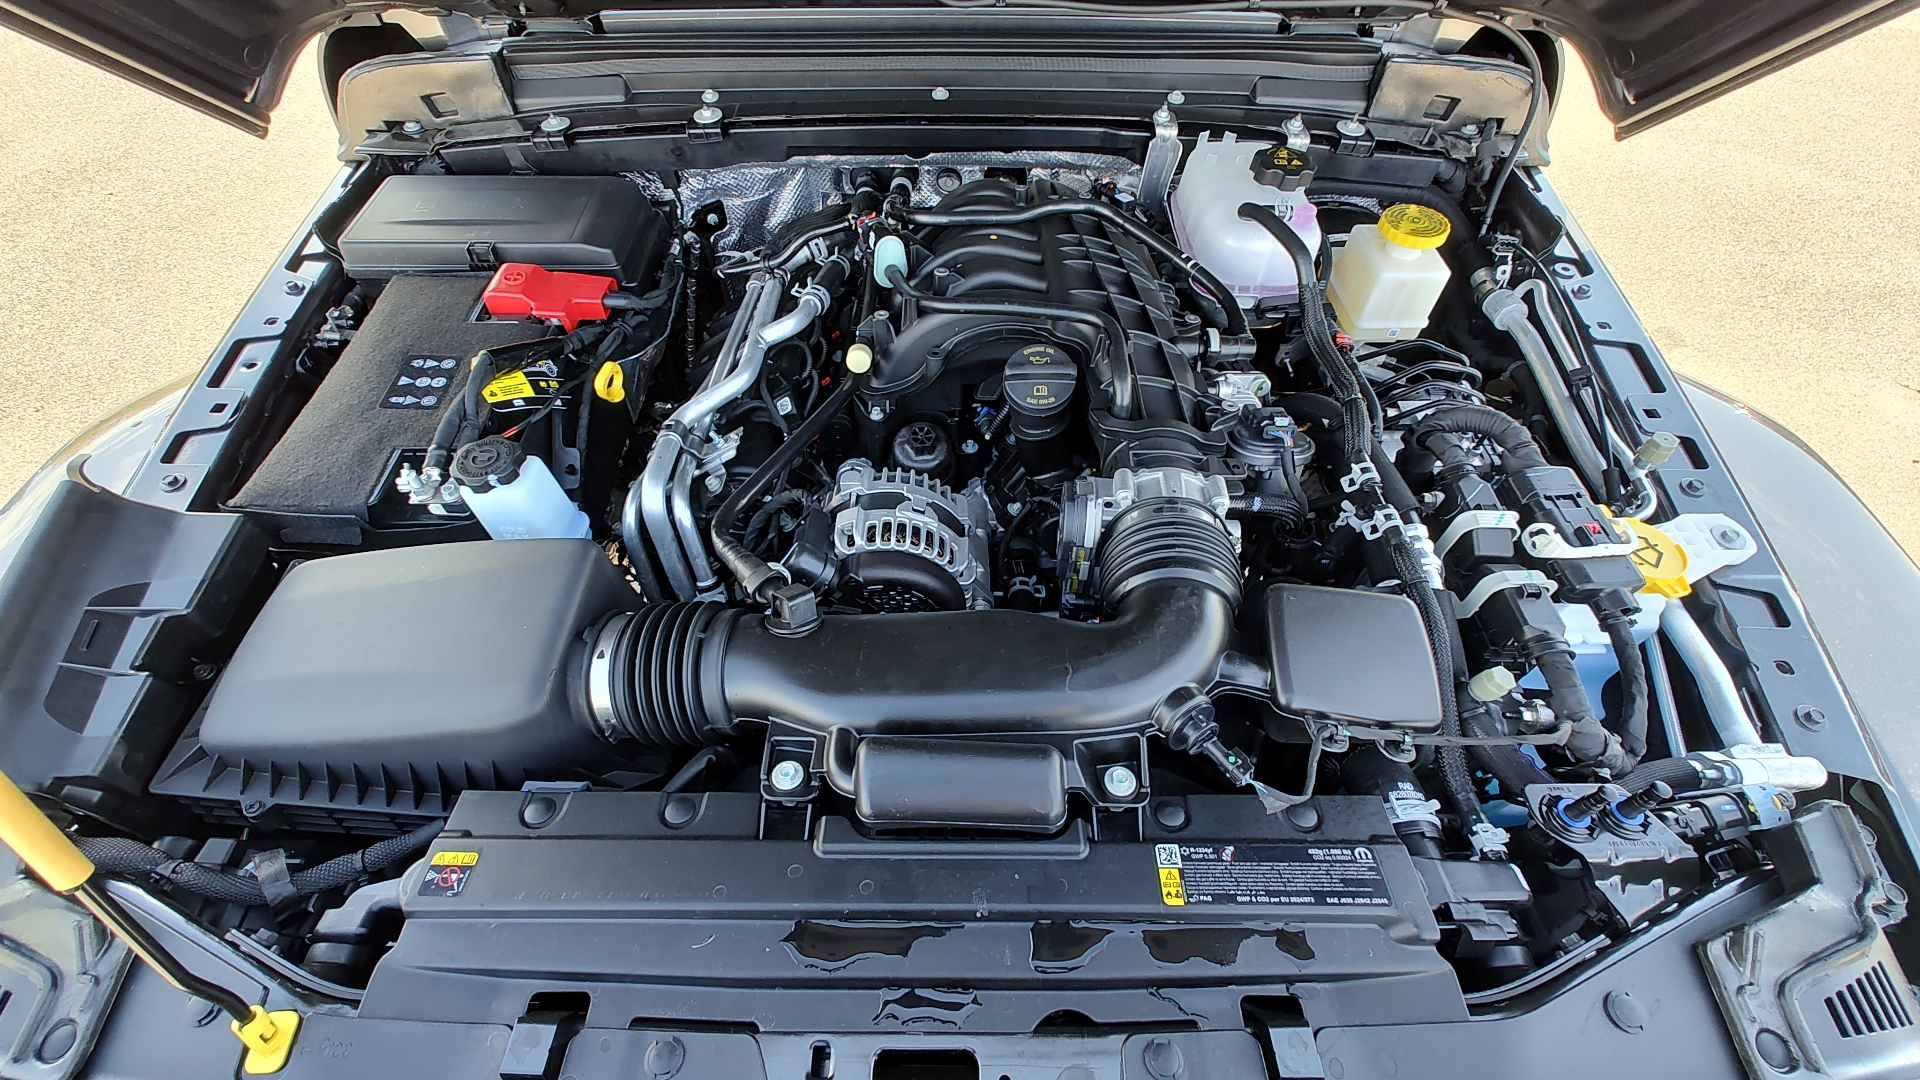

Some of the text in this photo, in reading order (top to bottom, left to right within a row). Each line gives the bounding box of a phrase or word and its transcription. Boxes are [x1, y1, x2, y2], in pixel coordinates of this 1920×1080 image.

[1023, 346, 1055, 355] ENGINE OIL
[1025, 396, 1038, 404] SAE
[1397, 782, 1414, 790] RAD
[1236, 895, 1250, 903] GWP
